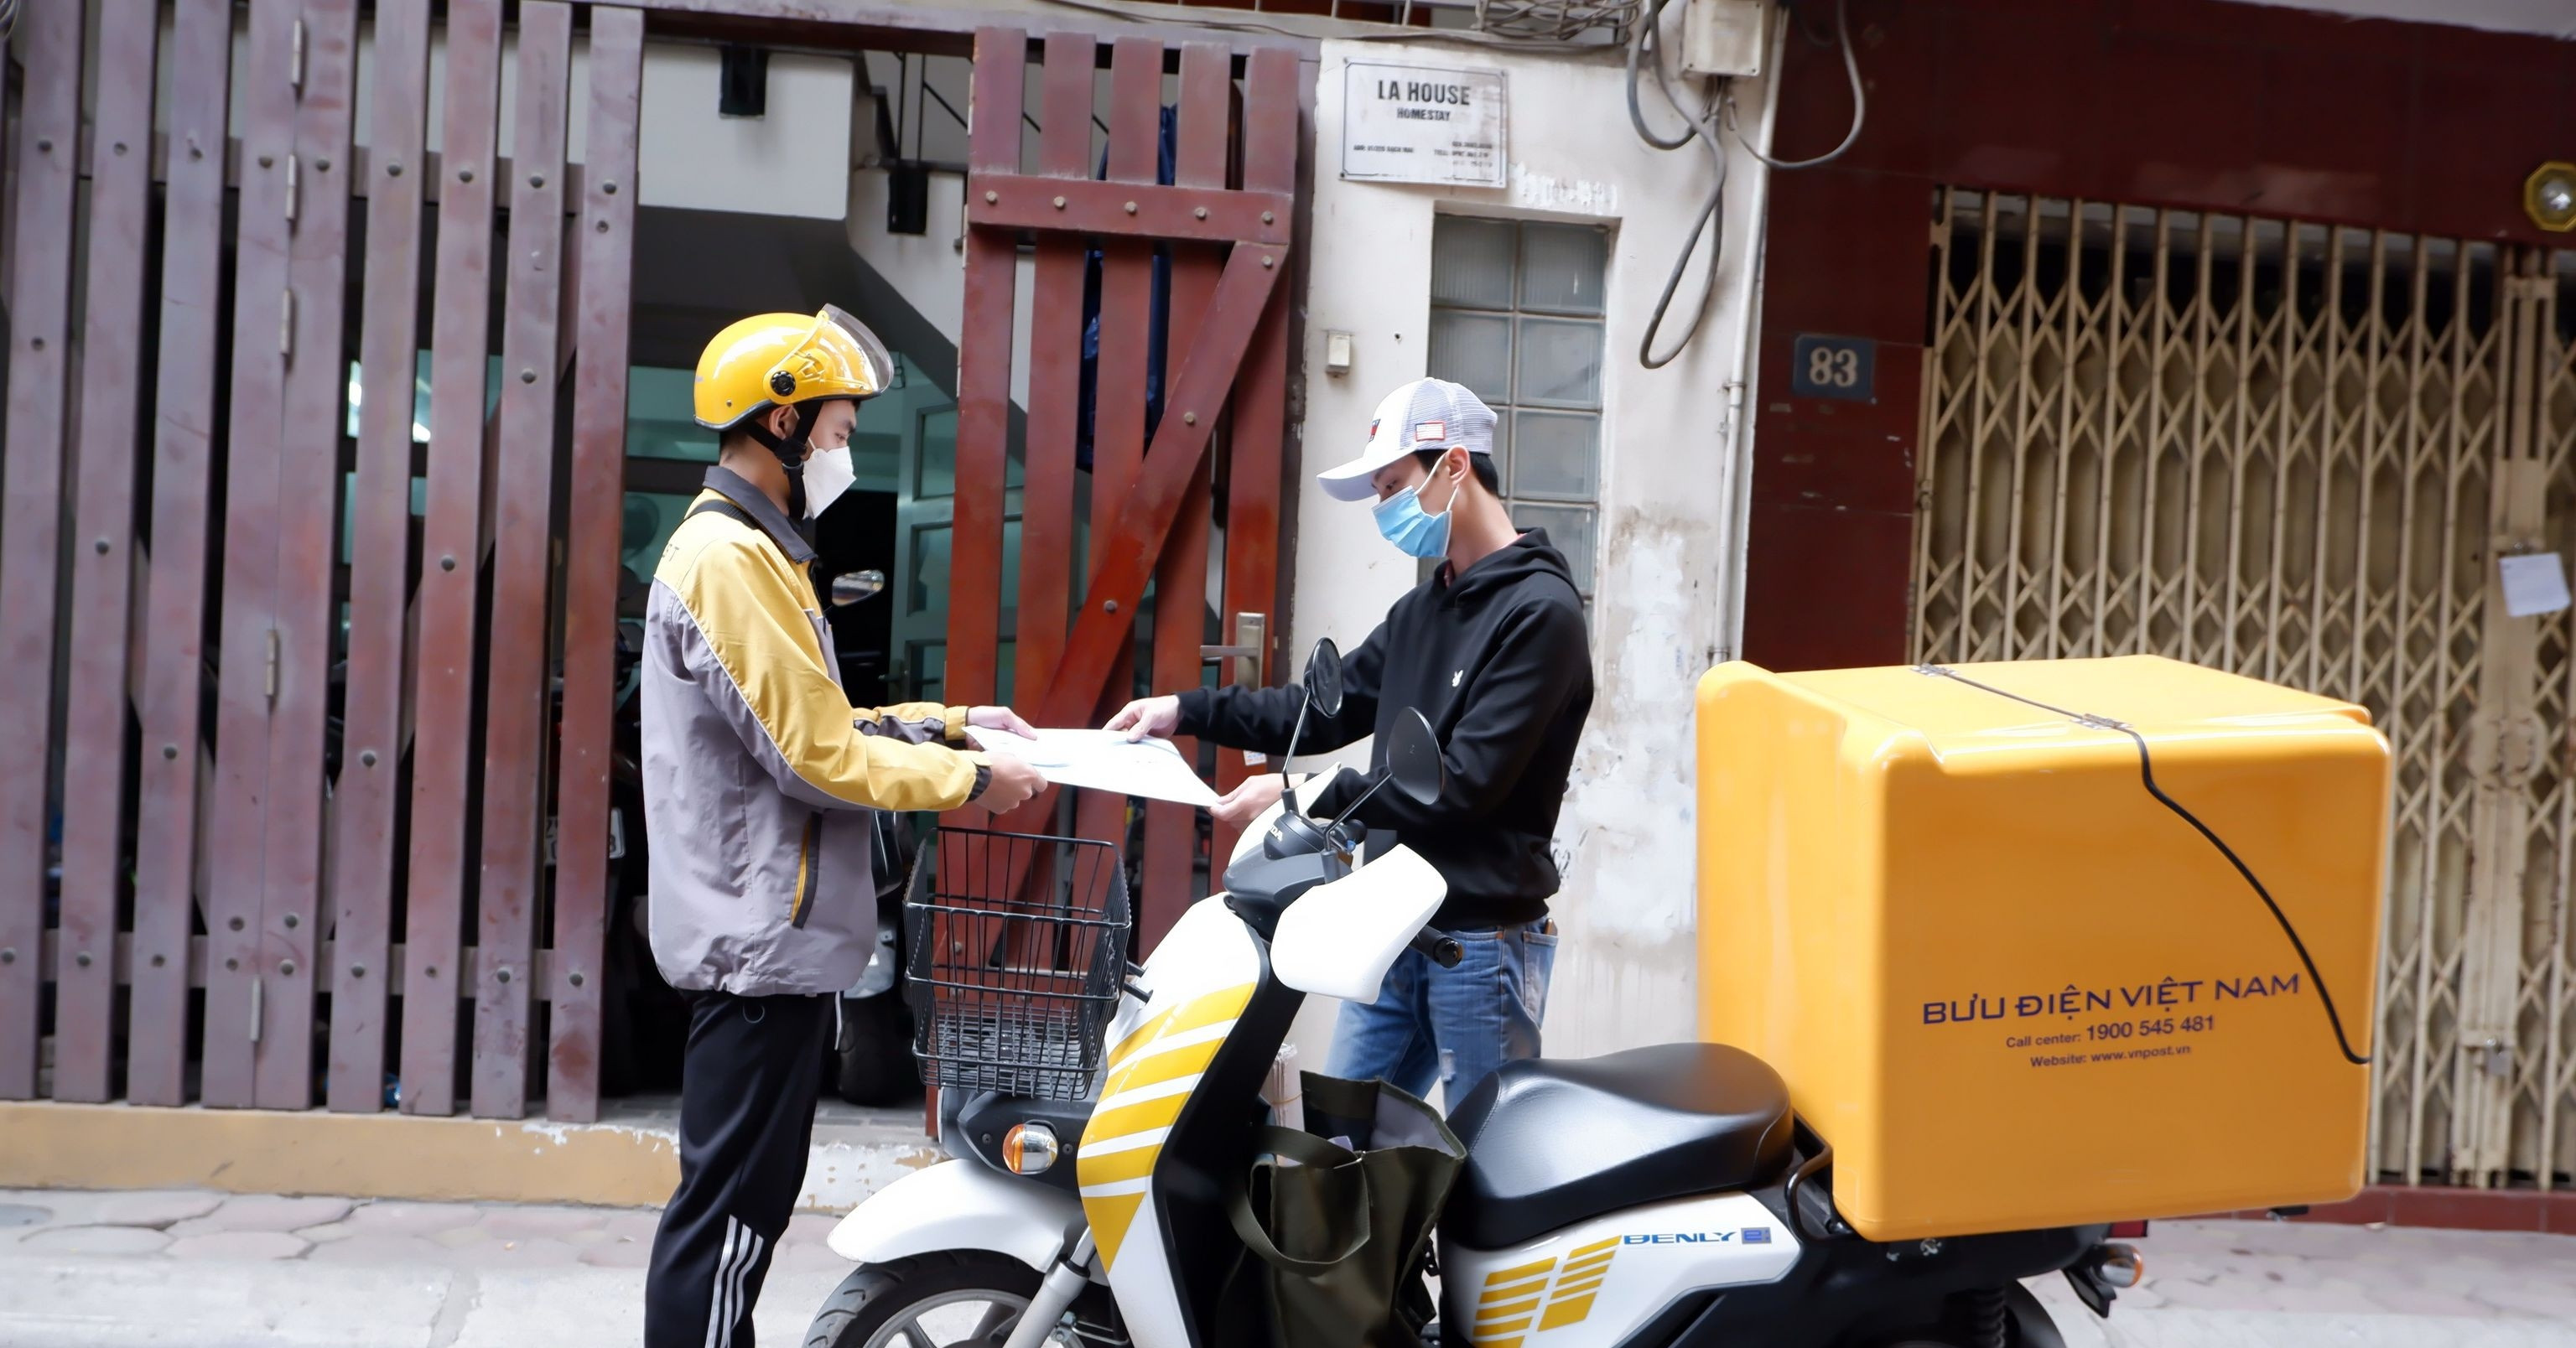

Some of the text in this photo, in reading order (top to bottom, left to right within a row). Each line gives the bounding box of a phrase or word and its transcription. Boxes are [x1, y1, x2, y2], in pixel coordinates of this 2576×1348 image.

[1378, 80, 1471, 106] LA HOUSE
[1396, 107, 1451, 122] HOMESTAY
[1809, 346, 1858, 388] 83
[1923, 972, 2298, 1024] BƯU ĐIỆN VIỆT NAM
[2006, 1014, 2215, 1048] Call center: 1900 545 481
[2030, 1045, 2192, 1067] Website: www.vnpost.vn
[1623, 1231, 1737, 1245] BENLY
